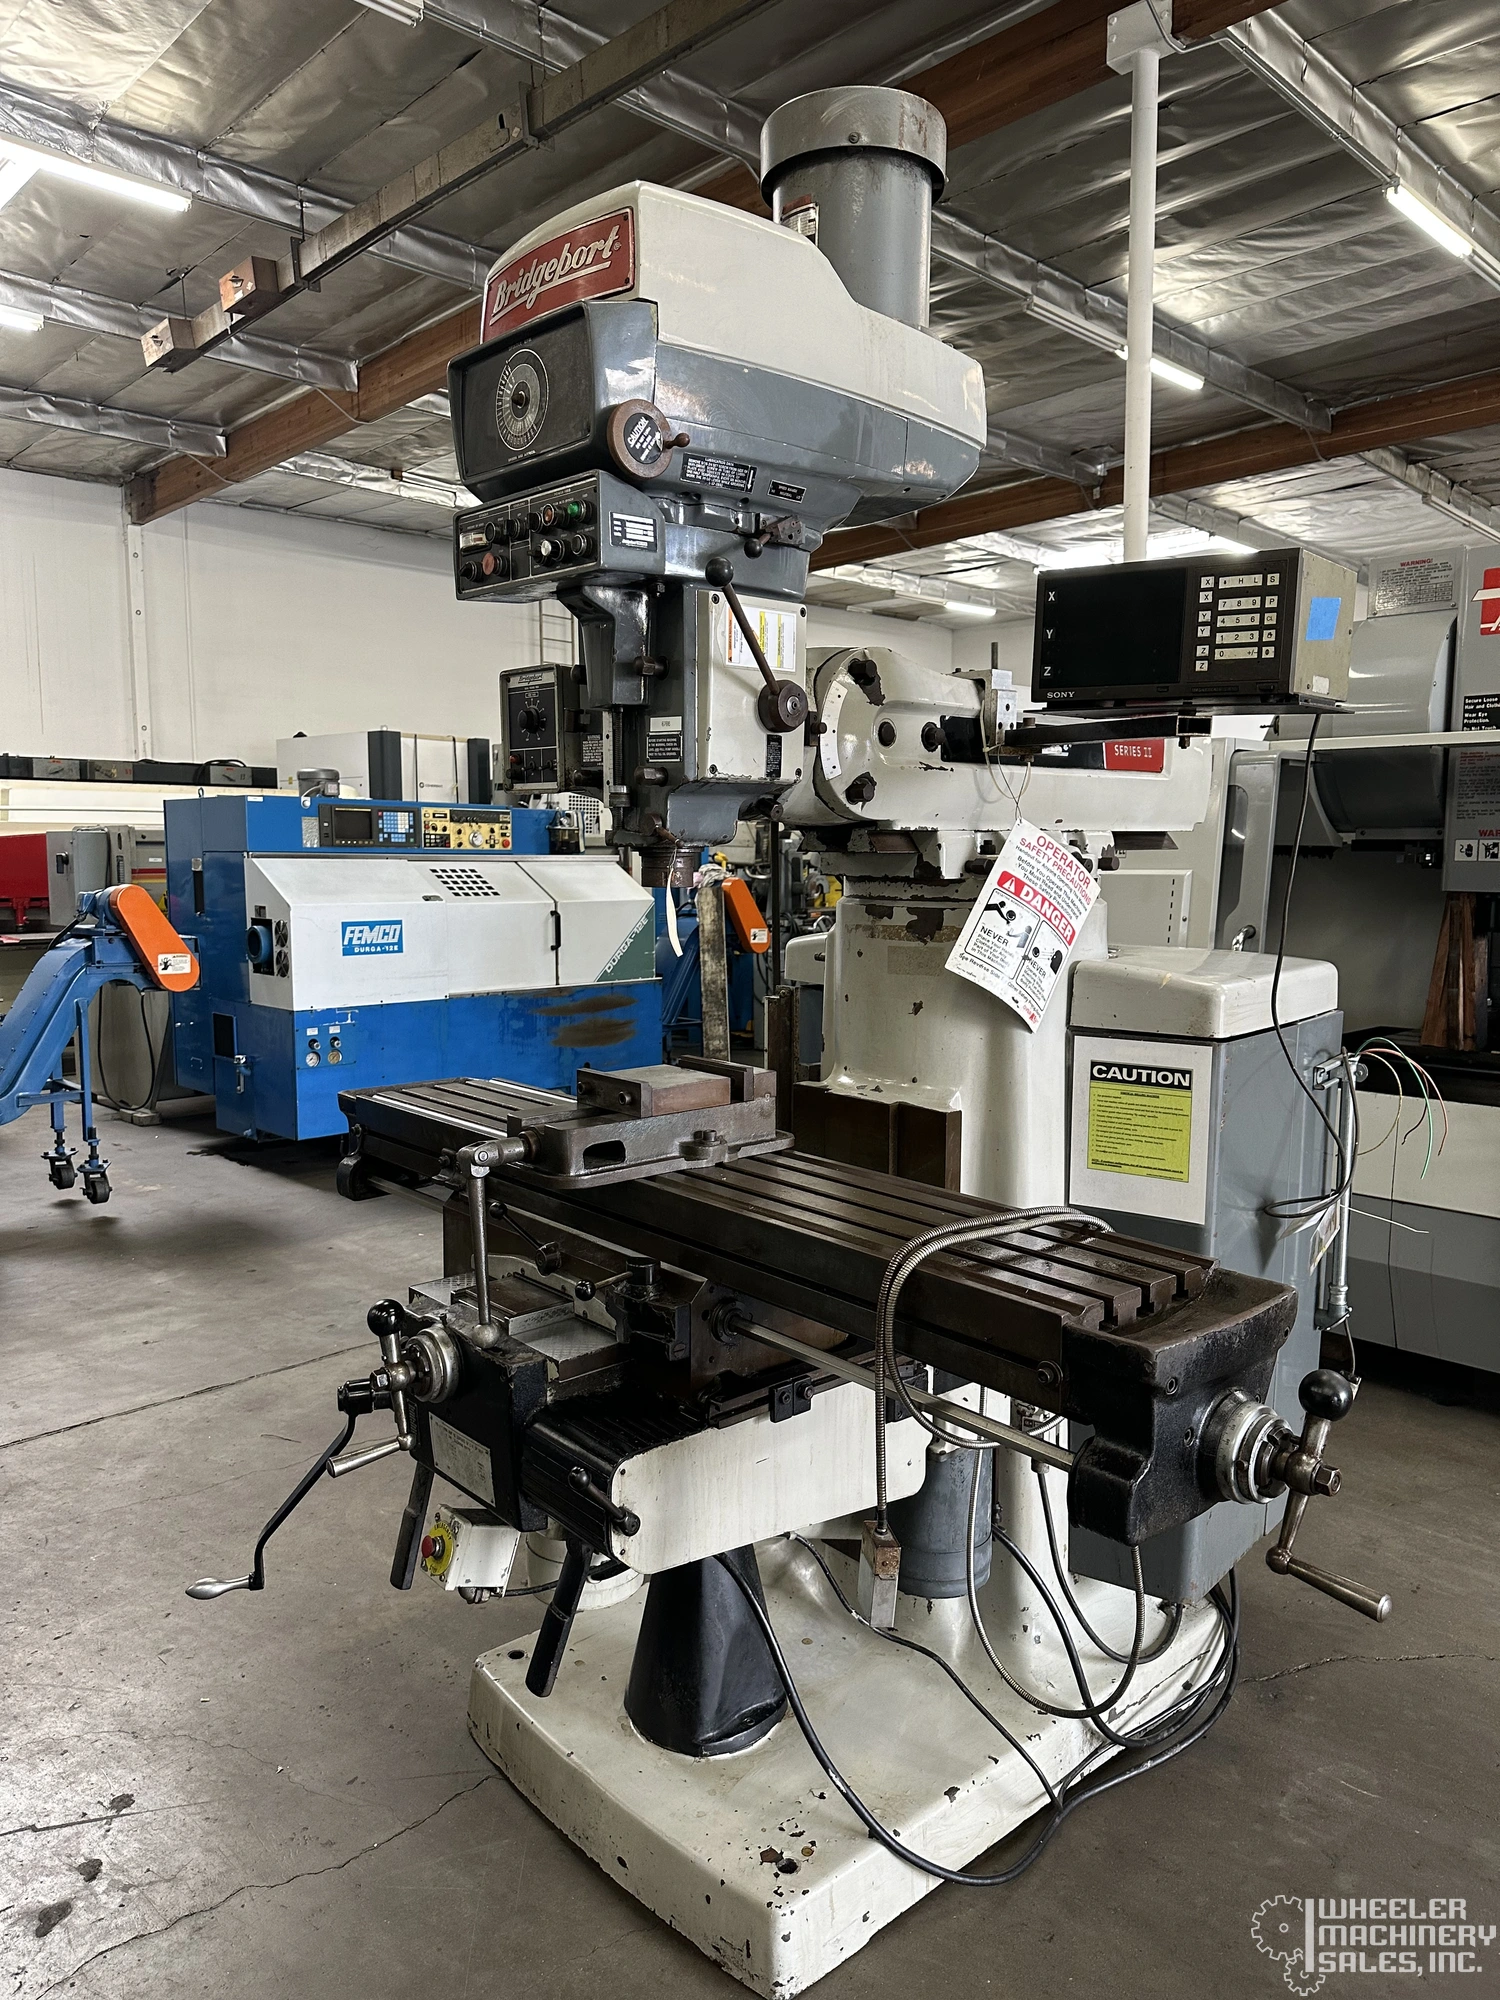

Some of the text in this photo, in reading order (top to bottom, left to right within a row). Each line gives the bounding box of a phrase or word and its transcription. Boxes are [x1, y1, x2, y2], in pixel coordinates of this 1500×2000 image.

[491, 225, 620, 318] Bridgeport
[627, 416, 650, 448] CAUTION
[1400, 558, 1433, 567] WARNING!
[1048, 591, 1056, 602] X
[1046, 629, 1054, 639] Y
[1043, 666, 1052, 676] Z
[1046, 691, 1075, 699] SONY
[1114, 744, 1152, 758] SERIES II
[1015, 844, 1035, 860] Handout
[1041, 862, 1057, 877] Anyone
[1019, 838, 1091, 905] SAFETY PRECAUTIONS
[1035, 836, 1091, 889] OPERATOR
[1017, 854, 1082, 915] Before You Operate This Machine
[1018, 861, 1028, 873] You
[1028, 869, 1041, 881] Must
[1040, 878, 1054, 891] Read
[1060, 896, 1079, 919] Understand
[1023, 872, 1038, 887] These
[1038, 883, 1053, 899] Safety
[1052, 895, 1073, 919] Precautions
[1018, 885, 1073, 942] DANGER
[343, 924, 402, 945] FEMCO
[605, 917, 649, 973] DURGA-12E
[980, 925, 1009, 946] NEVER
[354, 945, 399, 953] DURGA-12E
[969, 958, 989, 972] Reverse
[1092, 1065, 1190, 1087] CAUTION
